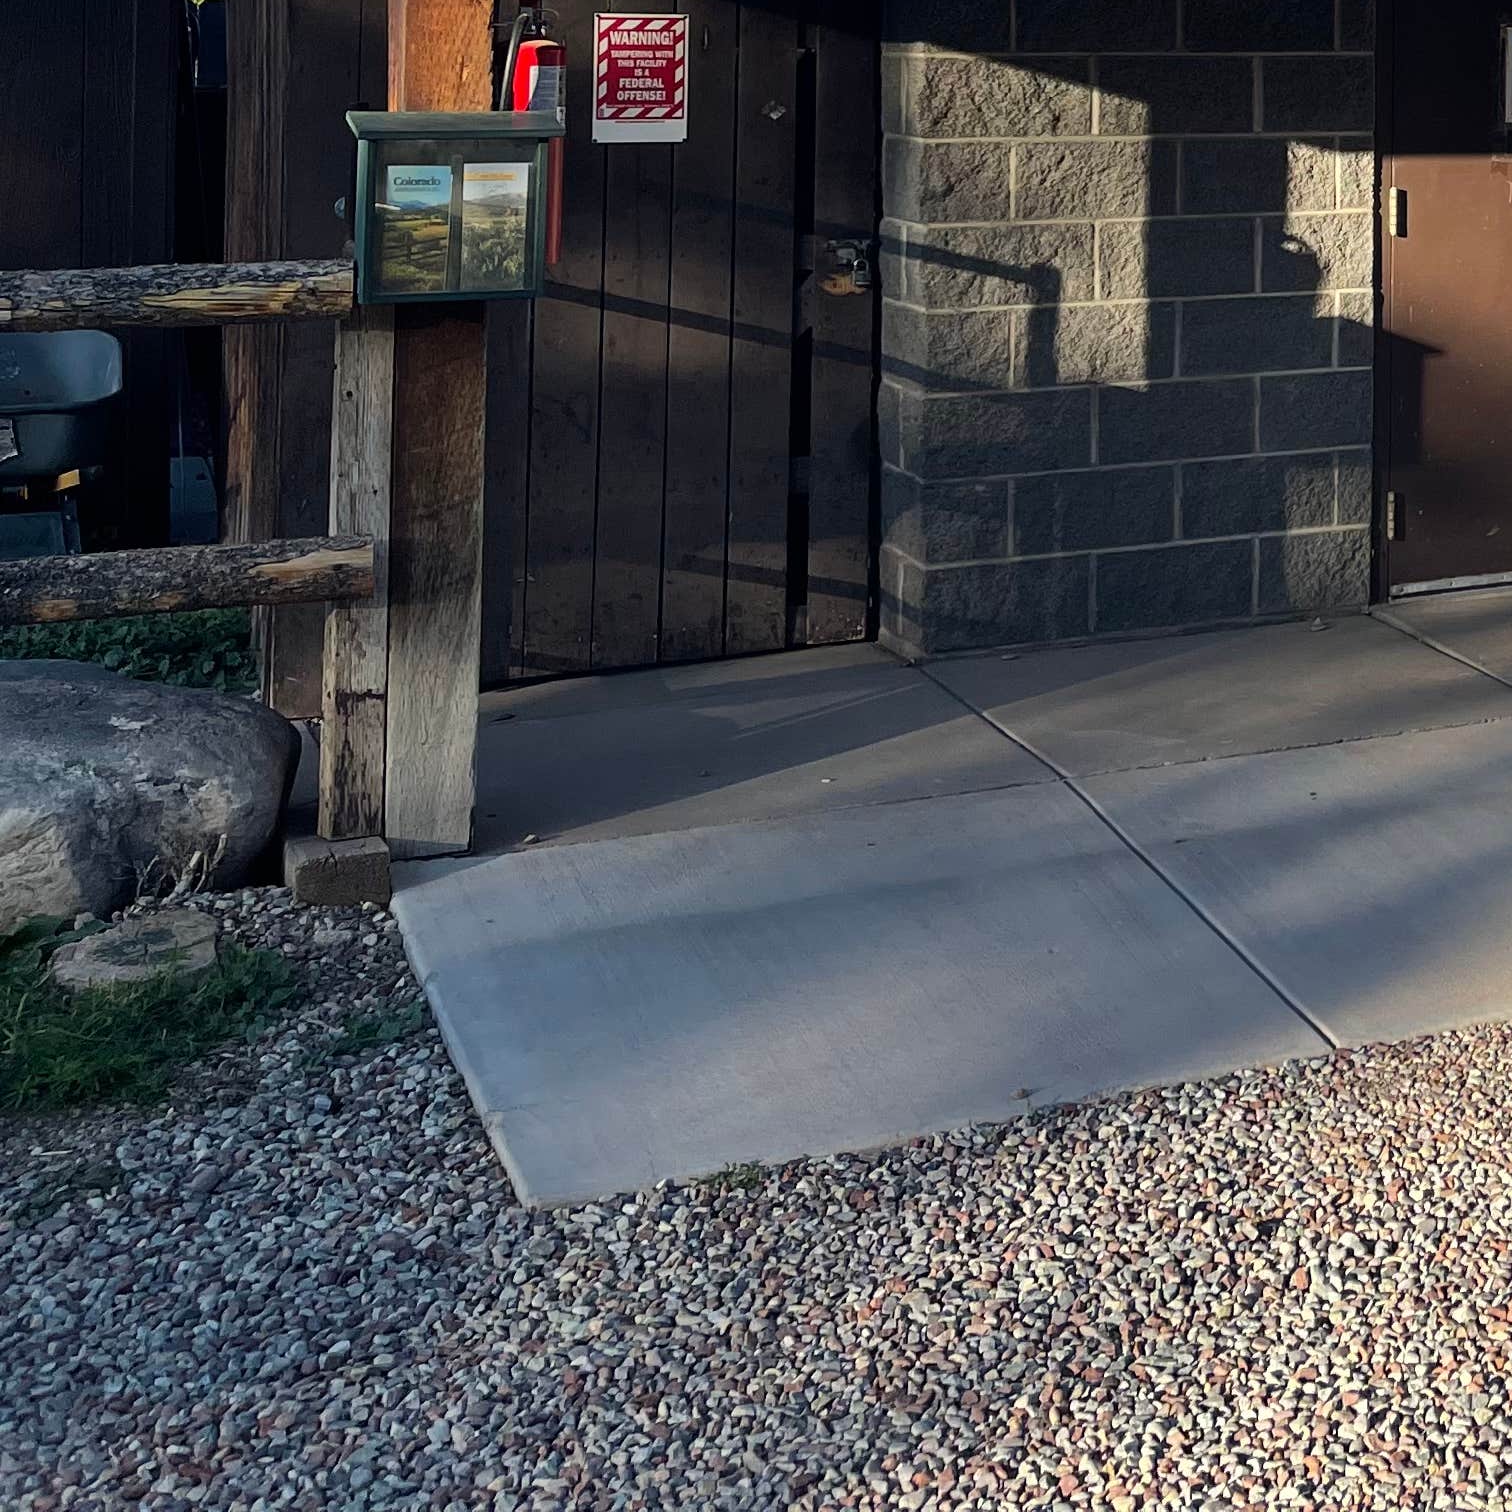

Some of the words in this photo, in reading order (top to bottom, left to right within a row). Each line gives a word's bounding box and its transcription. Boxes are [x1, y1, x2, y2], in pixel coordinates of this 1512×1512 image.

[609, 30, 674, 46] WARNING!
[643, 69, 650, 77] A
[619, 78, 664, 88] FEDERAL
[616, 90, 666, 101] OFFENSE!
[393, 176, 441, 186] Colorado
